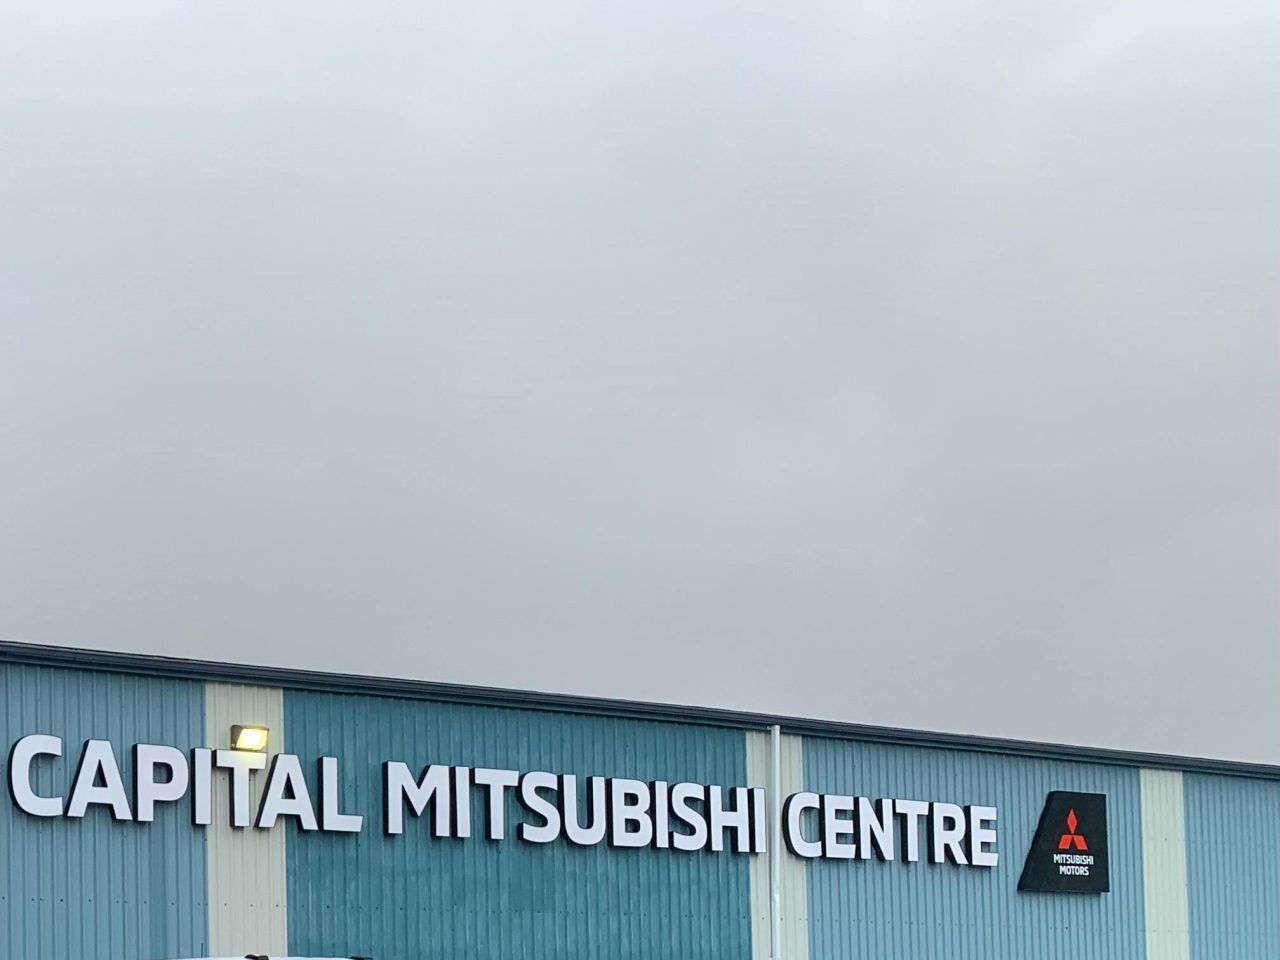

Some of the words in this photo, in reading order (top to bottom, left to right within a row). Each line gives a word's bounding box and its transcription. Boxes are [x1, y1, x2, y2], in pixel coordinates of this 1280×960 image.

[9, 733, 364, 833] CAPITAL
[382, 760, 767, 854] MITSUBISHI
[784, 792, 999, 867] CENTRE
[1053, 853, 1094, 865] MITSUBISHI
[1059, 865, 1090, 876] MOTORS
